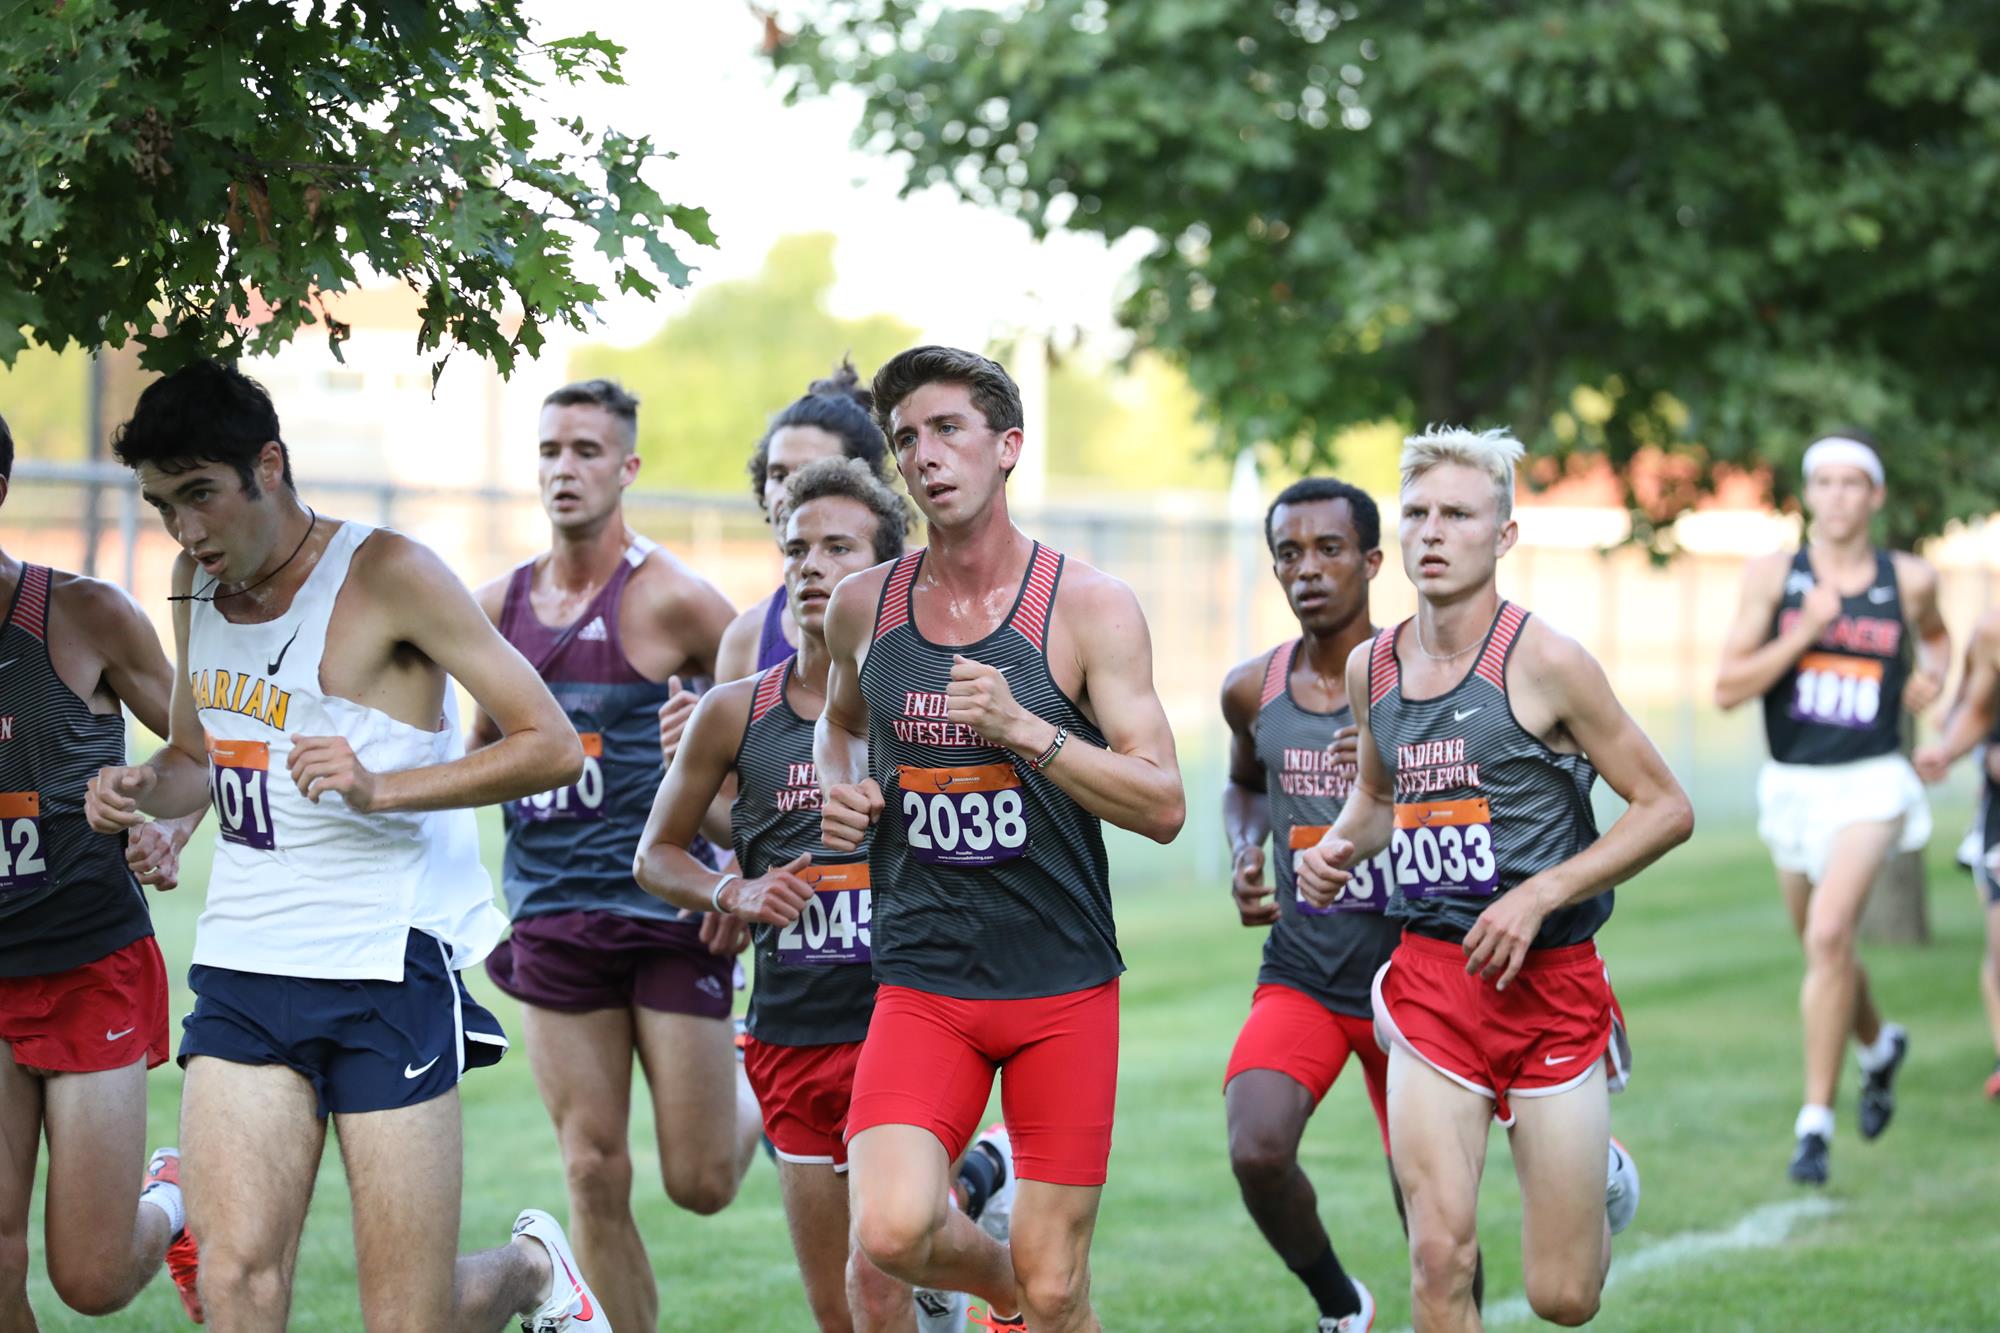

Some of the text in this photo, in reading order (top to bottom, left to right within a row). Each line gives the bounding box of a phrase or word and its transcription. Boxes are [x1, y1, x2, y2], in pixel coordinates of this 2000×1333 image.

[903, 691, 949, 717] INDI
[893, 720, 1004, 748] WESLEY
[1397, 737, 1465, 770] INDIANA
[1278, 771, 1353, 798] WESLEY
[903, 788, 1027, 851] 2038
[1391, 823, 1496, 885] 2033
